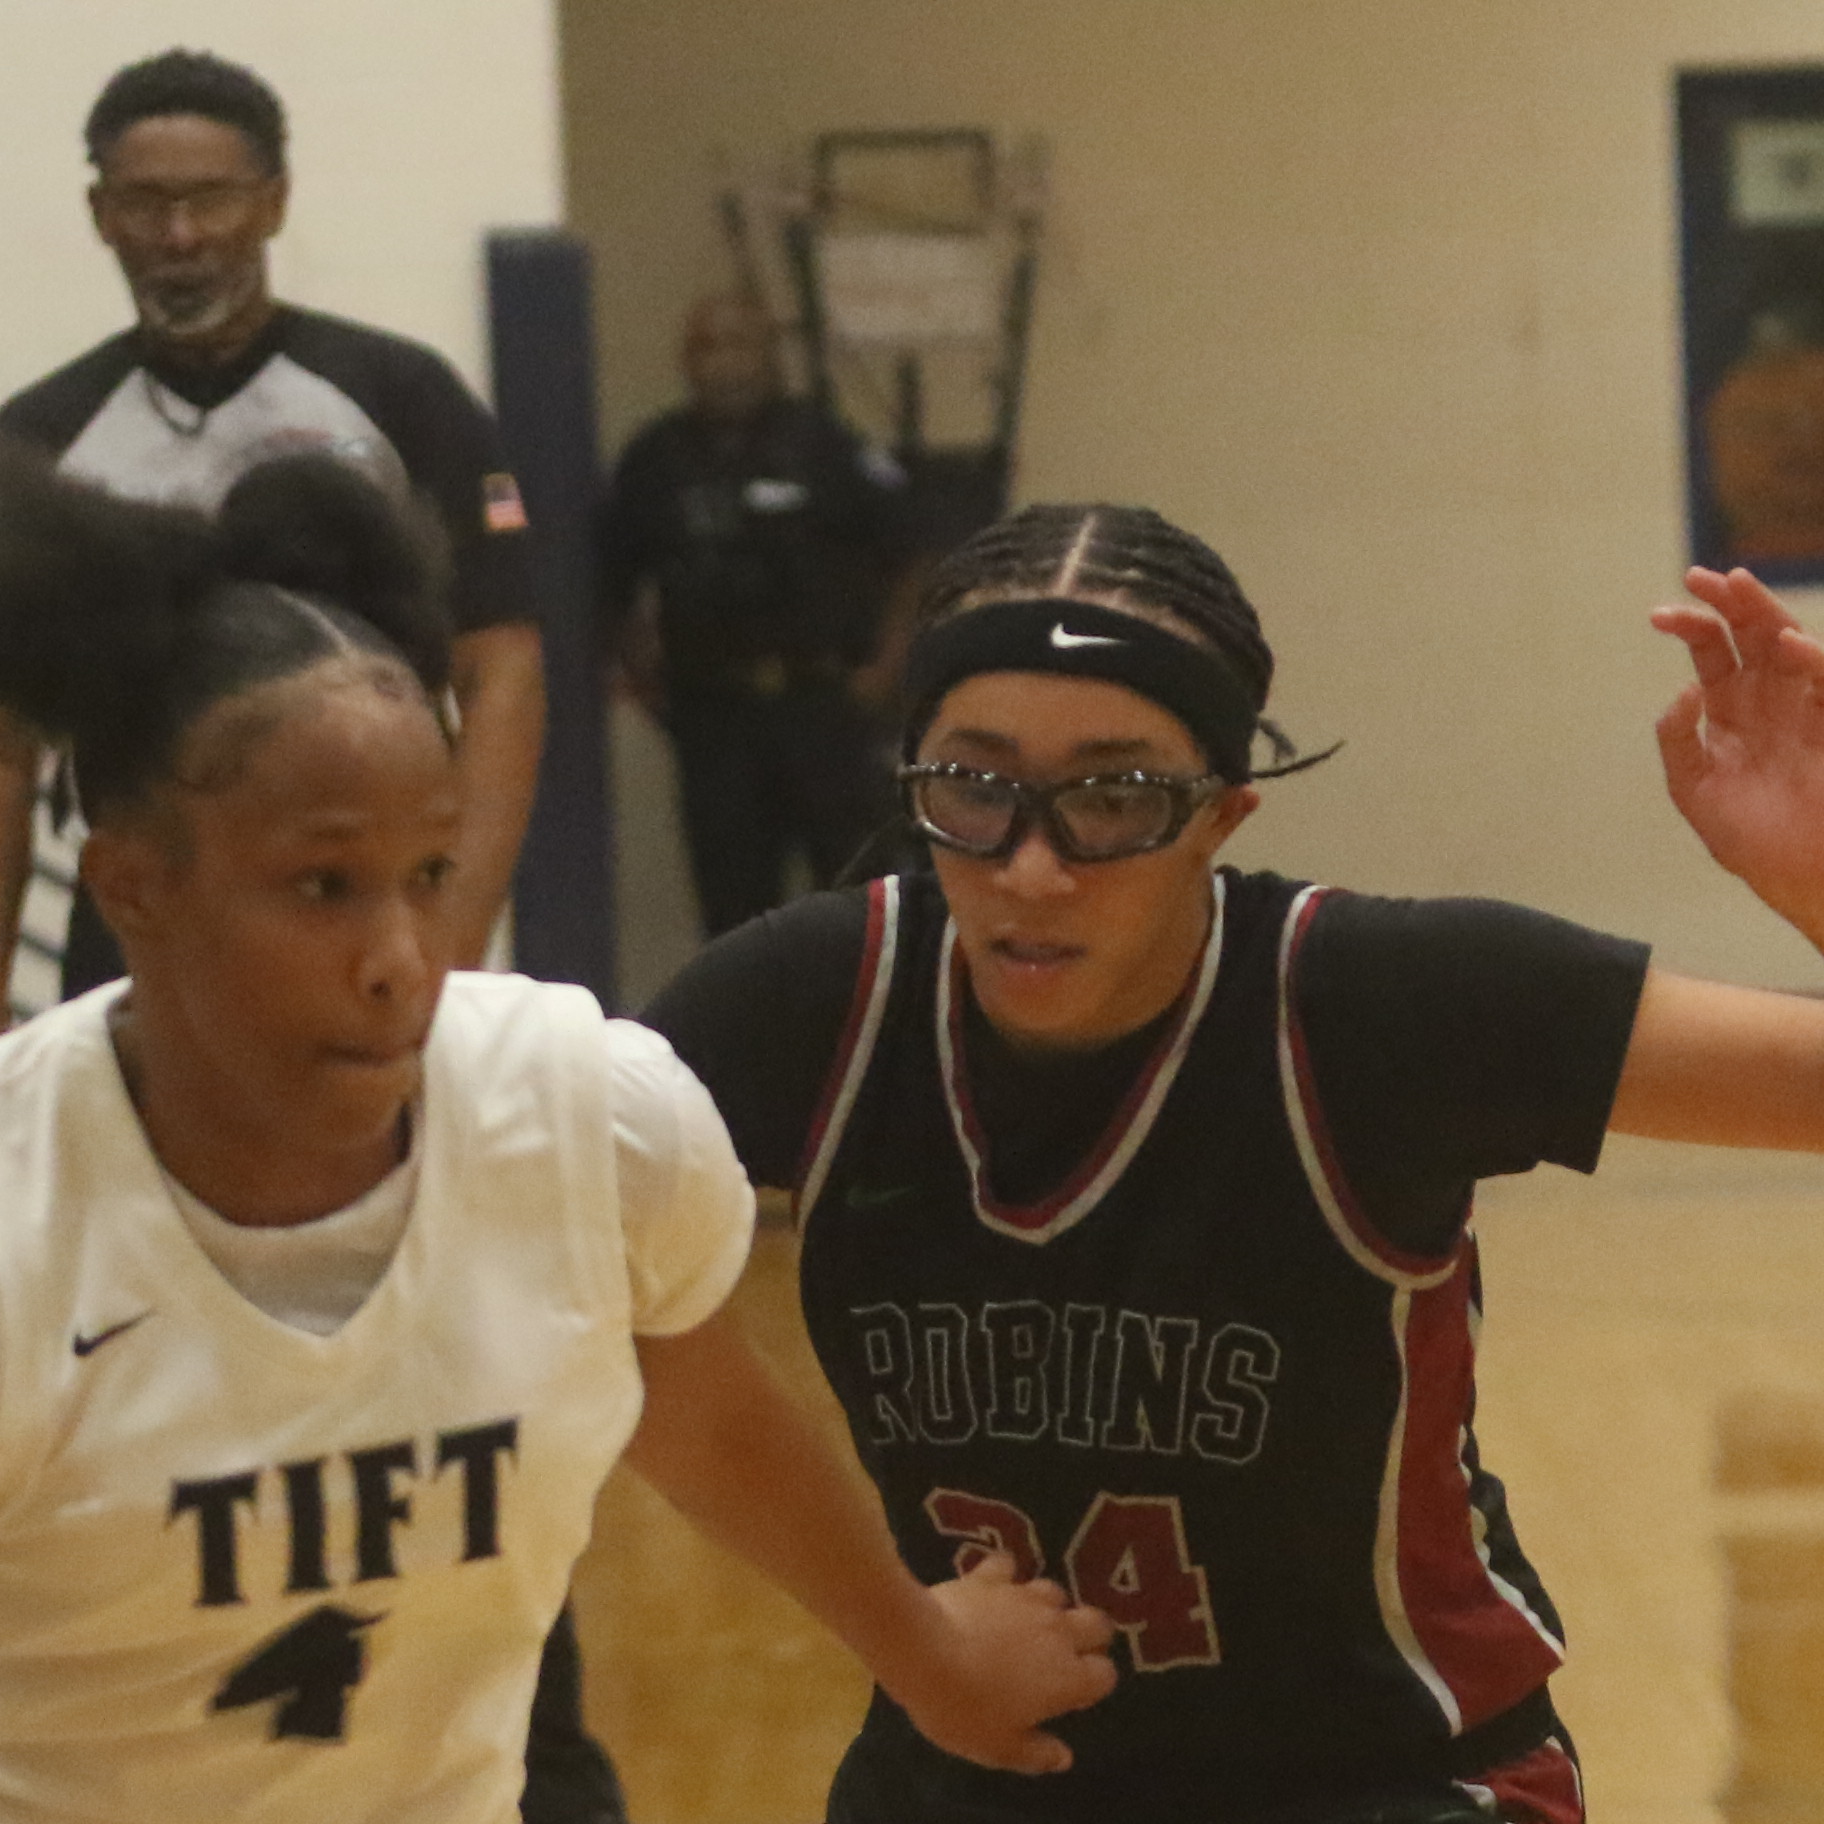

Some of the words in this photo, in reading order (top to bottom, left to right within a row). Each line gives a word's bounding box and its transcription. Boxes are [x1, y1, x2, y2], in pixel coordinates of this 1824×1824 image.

[848, 1299, 1281, 1466] ROBINS
[165, 1414, 520, 1609] TIFT
[207, 1603, 391, 1746] 4
